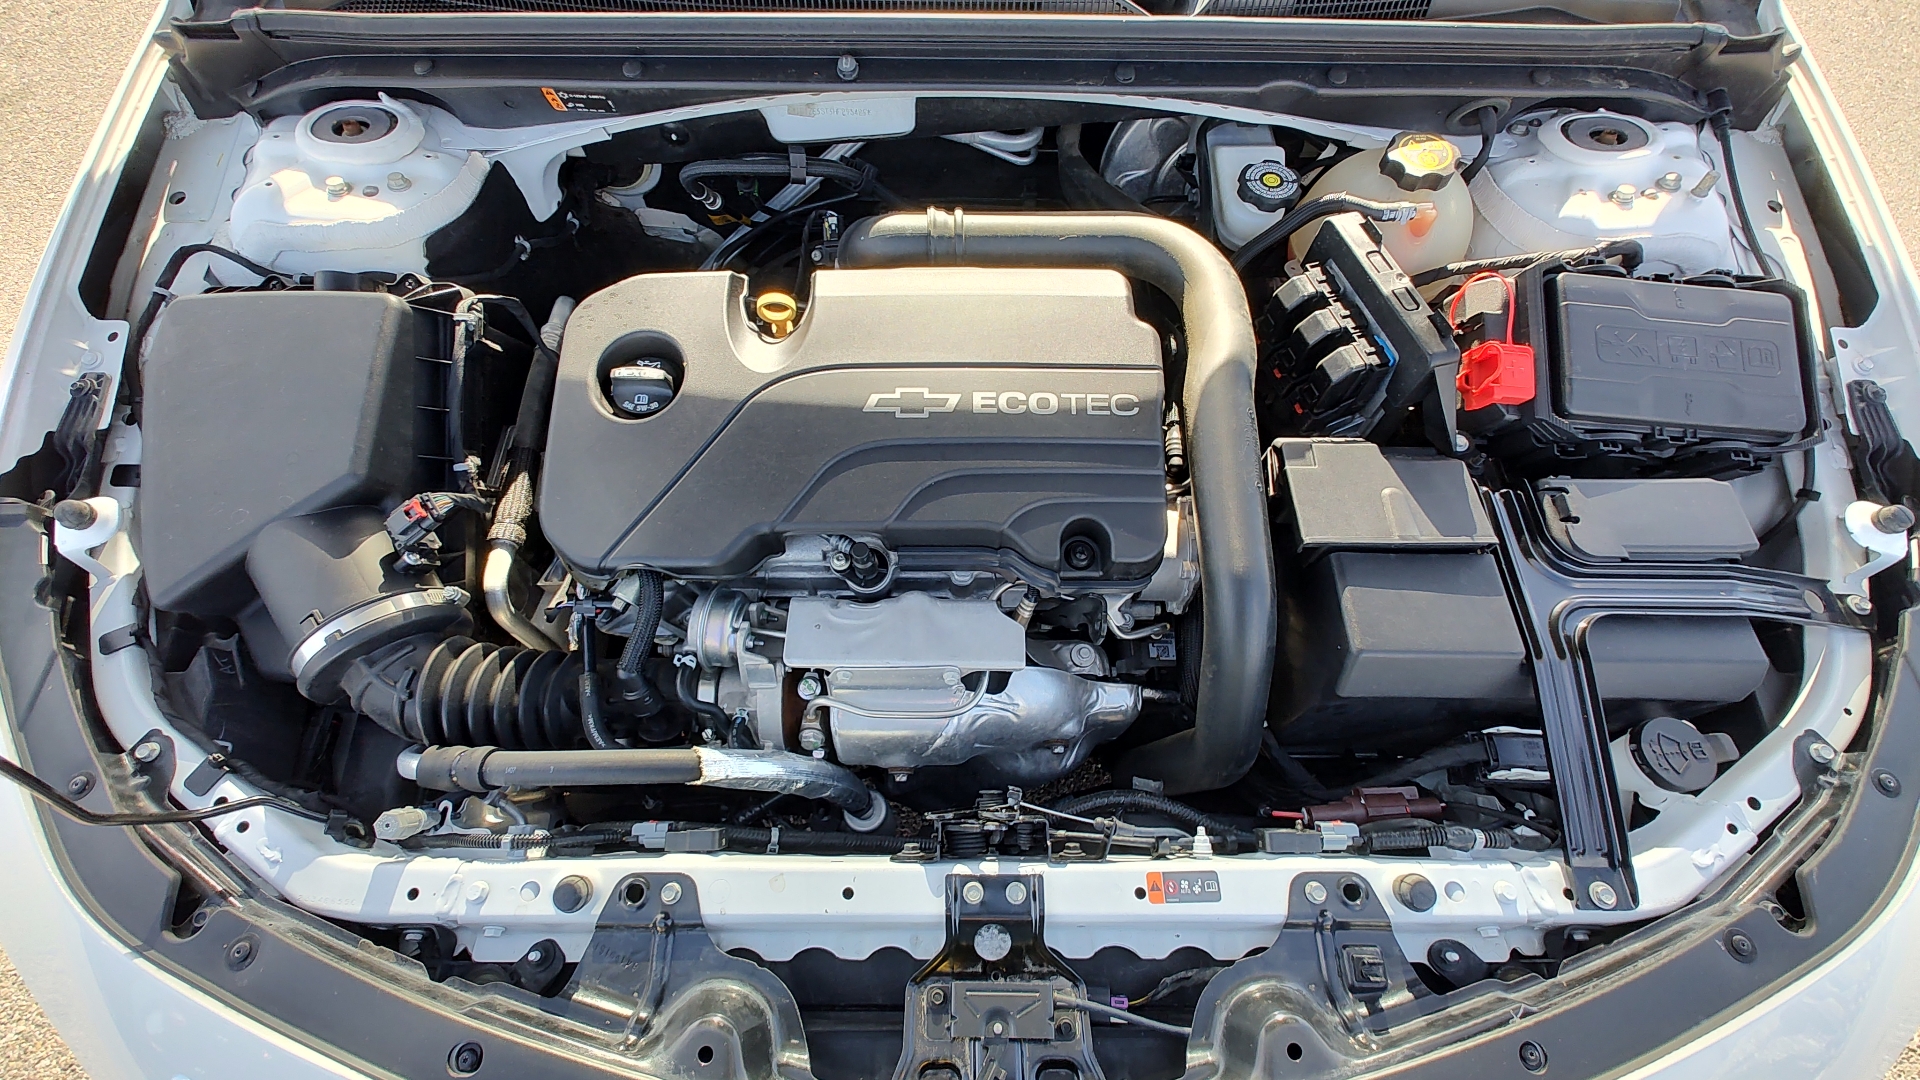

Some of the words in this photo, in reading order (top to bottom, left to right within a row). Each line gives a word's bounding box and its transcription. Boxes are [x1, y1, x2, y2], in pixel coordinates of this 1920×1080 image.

[622, 400, 636, 411] SAE
[636, 401, 660, 412] 5W-30
[972, 391, 1140, 416] ECOTEC
